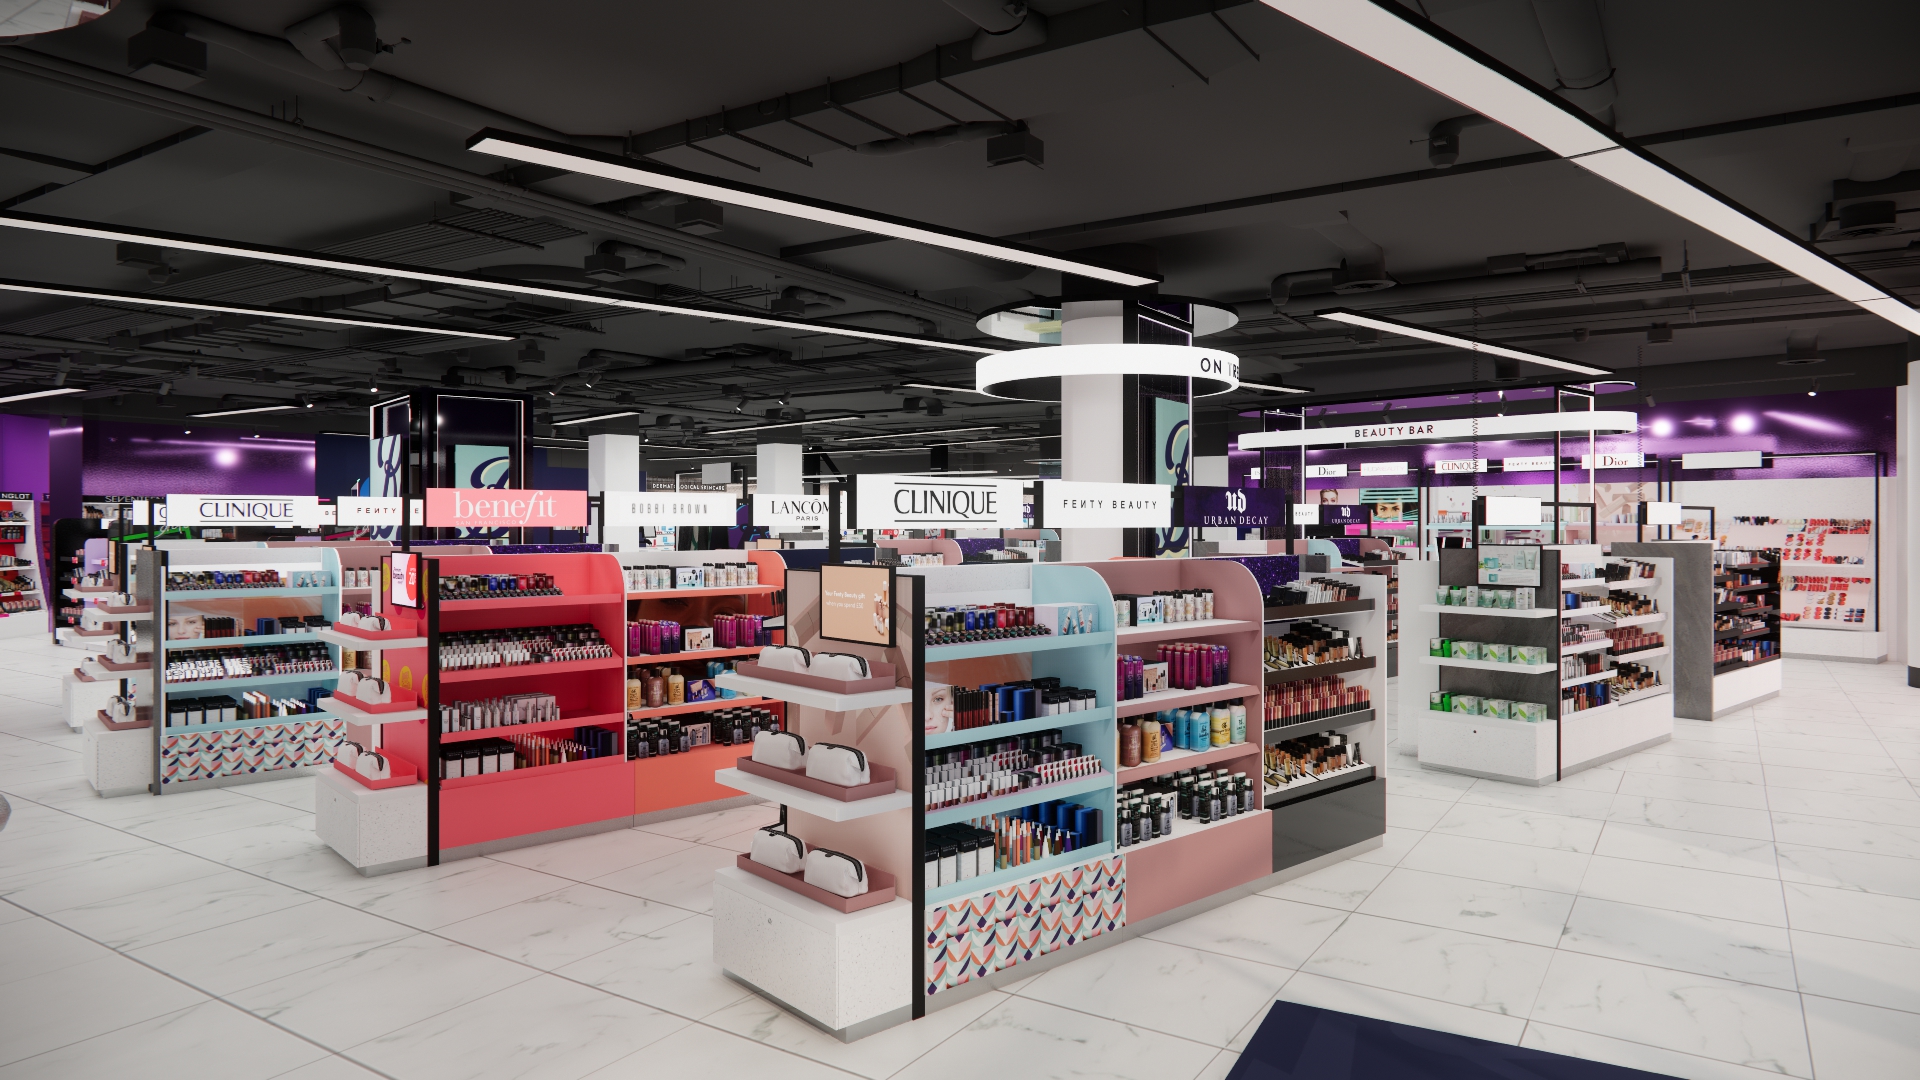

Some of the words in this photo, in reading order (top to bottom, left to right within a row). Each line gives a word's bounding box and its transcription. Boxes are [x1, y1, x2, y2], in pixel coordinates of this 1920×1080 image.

[1200, 357, 1222, 375] ON
[1354, 426, 1404, 438] BEAUTY
[1409, 424, 1434, 435] BAR
[1602, 455, 1629, 467] Dior
[1318, 466, 1336, 476] Dior
[652, 482, 700, 490] DERMATOGICAL
[452, 490, 558, 525] benefit
[631, 503, 665, 514] BOBBI
[672, 503, 708, 514] BROWN
[771, 498, 843, 515] LANCÔM
[893, 489, 998, 519] CLINIQUE
[1112, 500, 1157, 510] BEAUTY
[199, 502, 294, 521] CLINIQUE
[1203, 515, 1237, 528] URBAN
[1239, 515, 1269, 525] DECAY
